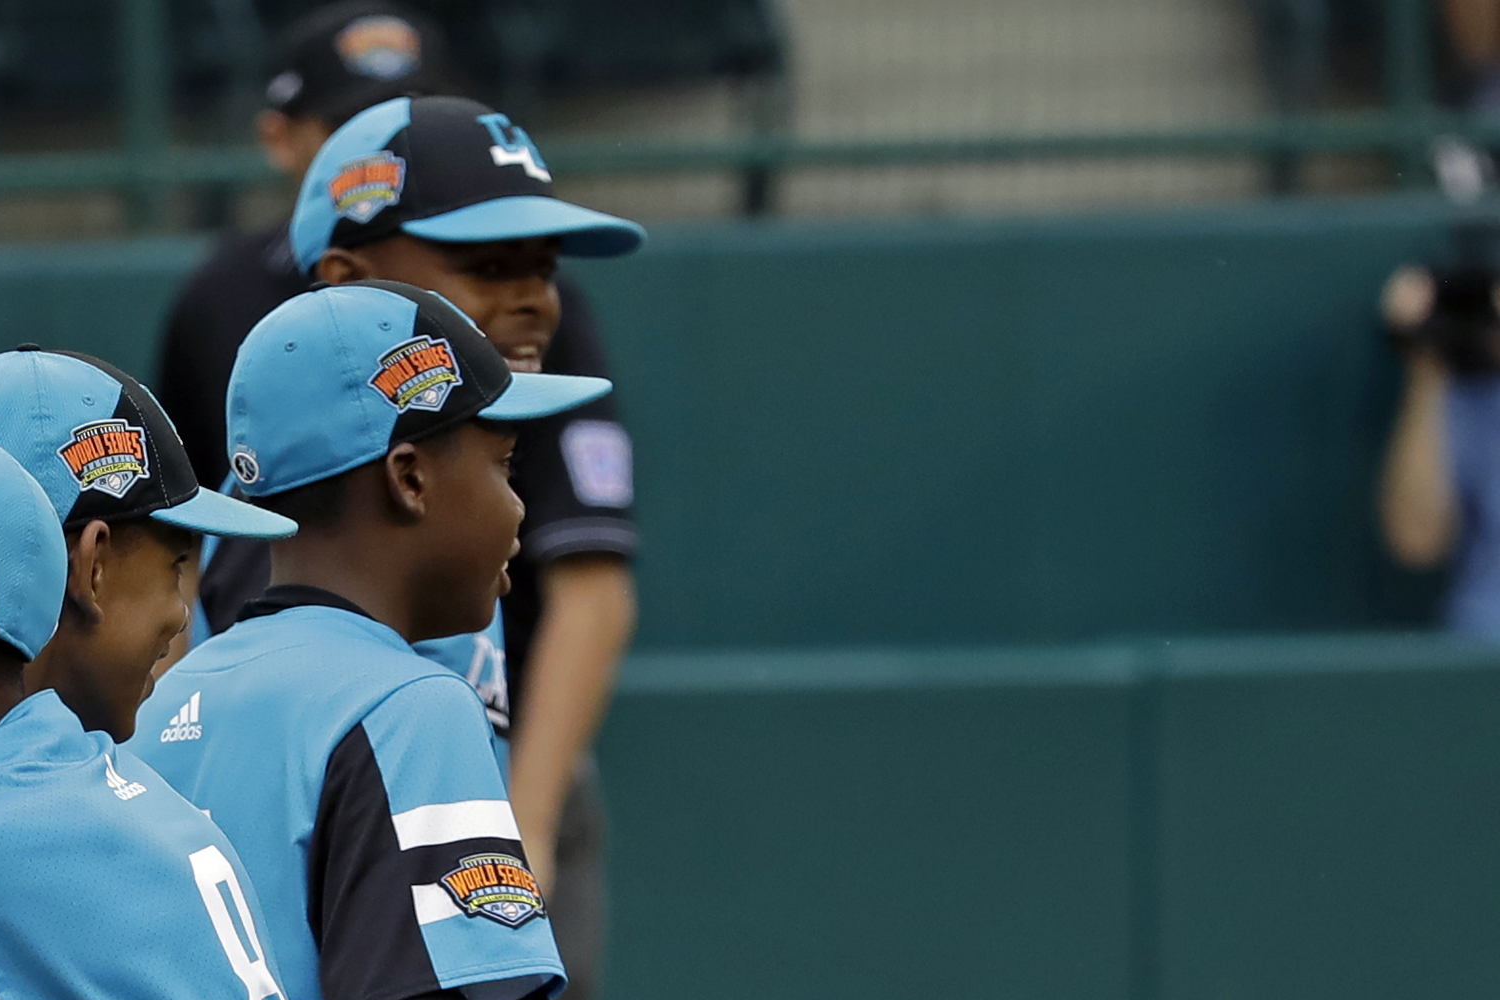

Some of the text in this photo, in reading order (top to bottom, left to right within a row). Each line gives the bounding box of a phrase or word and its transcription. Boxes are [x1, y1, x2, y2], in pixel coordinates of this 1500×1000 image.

[373, 358, 416, 398] WORLD
[409, 344, 453, 372] SERIES
[63, 431, 143, 473] WORLD SERIES
[160, 723, 203, 743] adidas
[113, 781, 148, 801] adidas
[446, 864, 541, 899] WORLD SERIES
